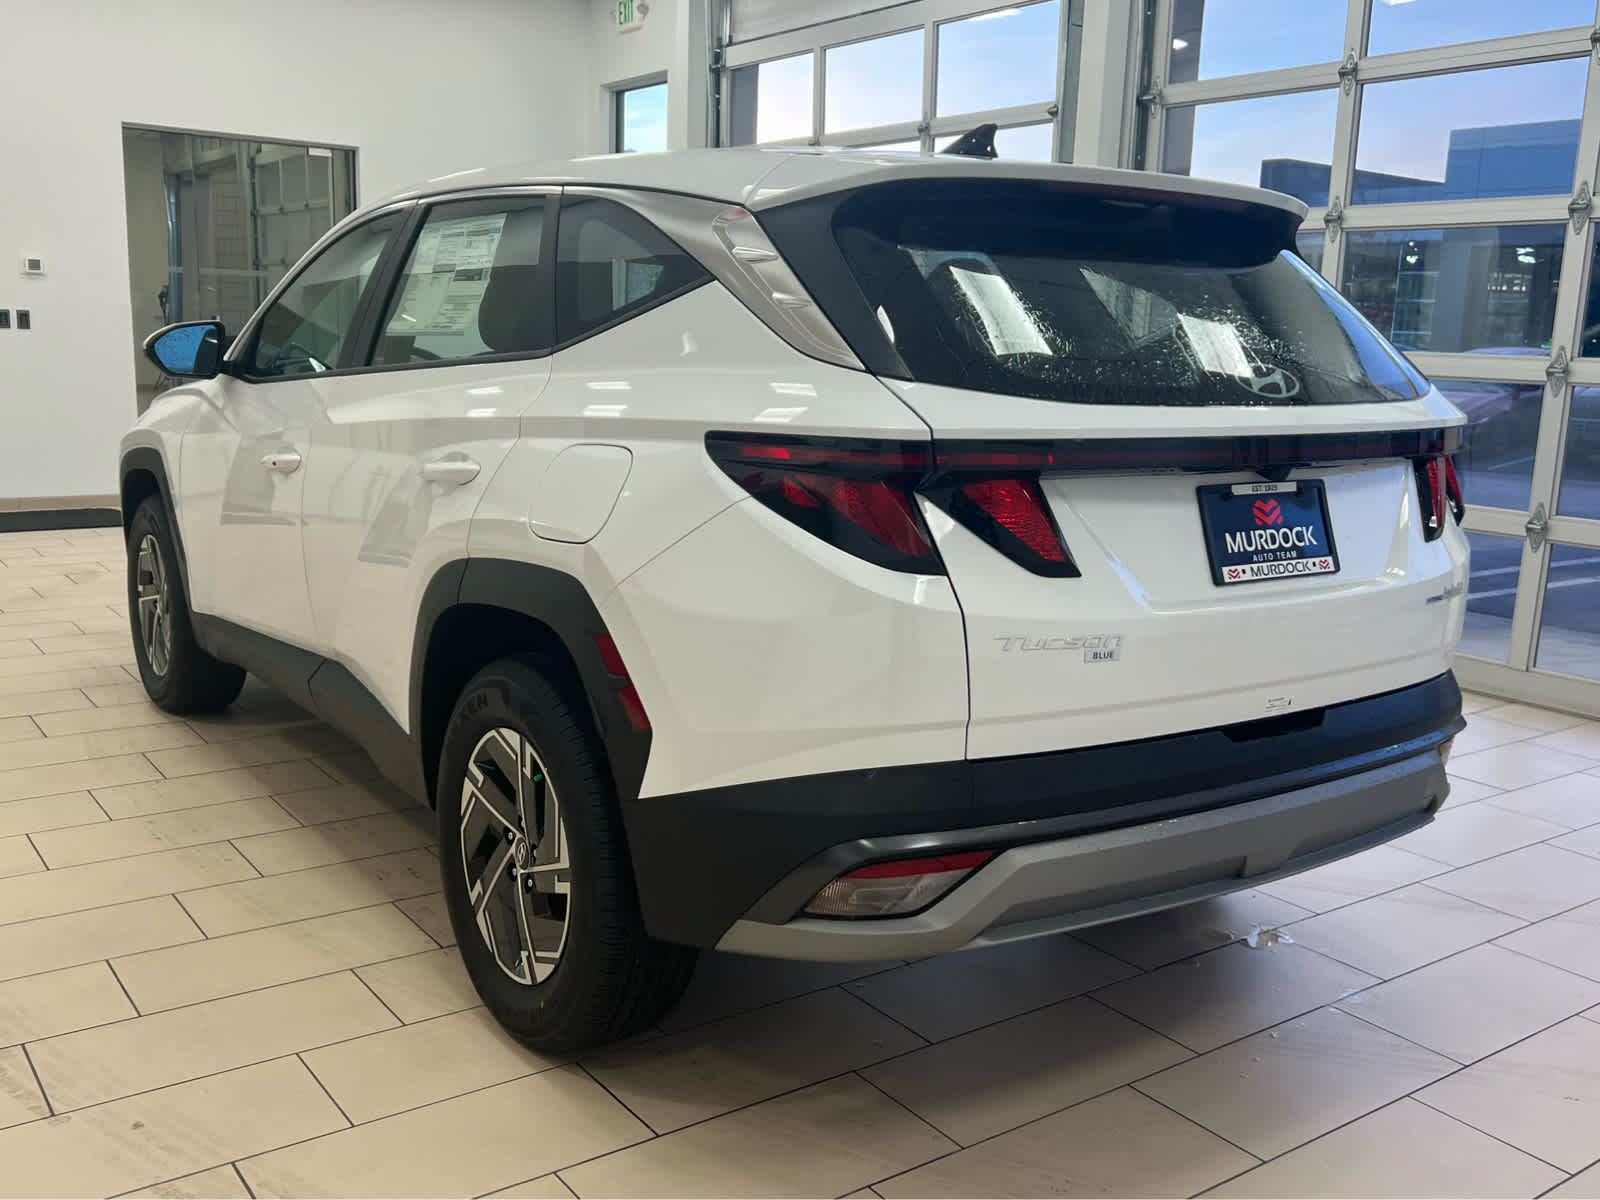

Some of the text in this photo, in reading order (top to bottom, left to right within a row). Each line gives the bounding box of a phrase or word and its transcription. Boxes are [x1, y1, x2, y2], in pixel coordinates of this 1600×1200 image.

[619, 0, 634, 25] EXIT
[1225, 526, 1317, 554] MURDOCK
[1253, 550, 1297, 562] AUTO TEAM
[1250, 561, 1311, 577] MURDOCK
[1092, 650, 1113, 660] BLUE
